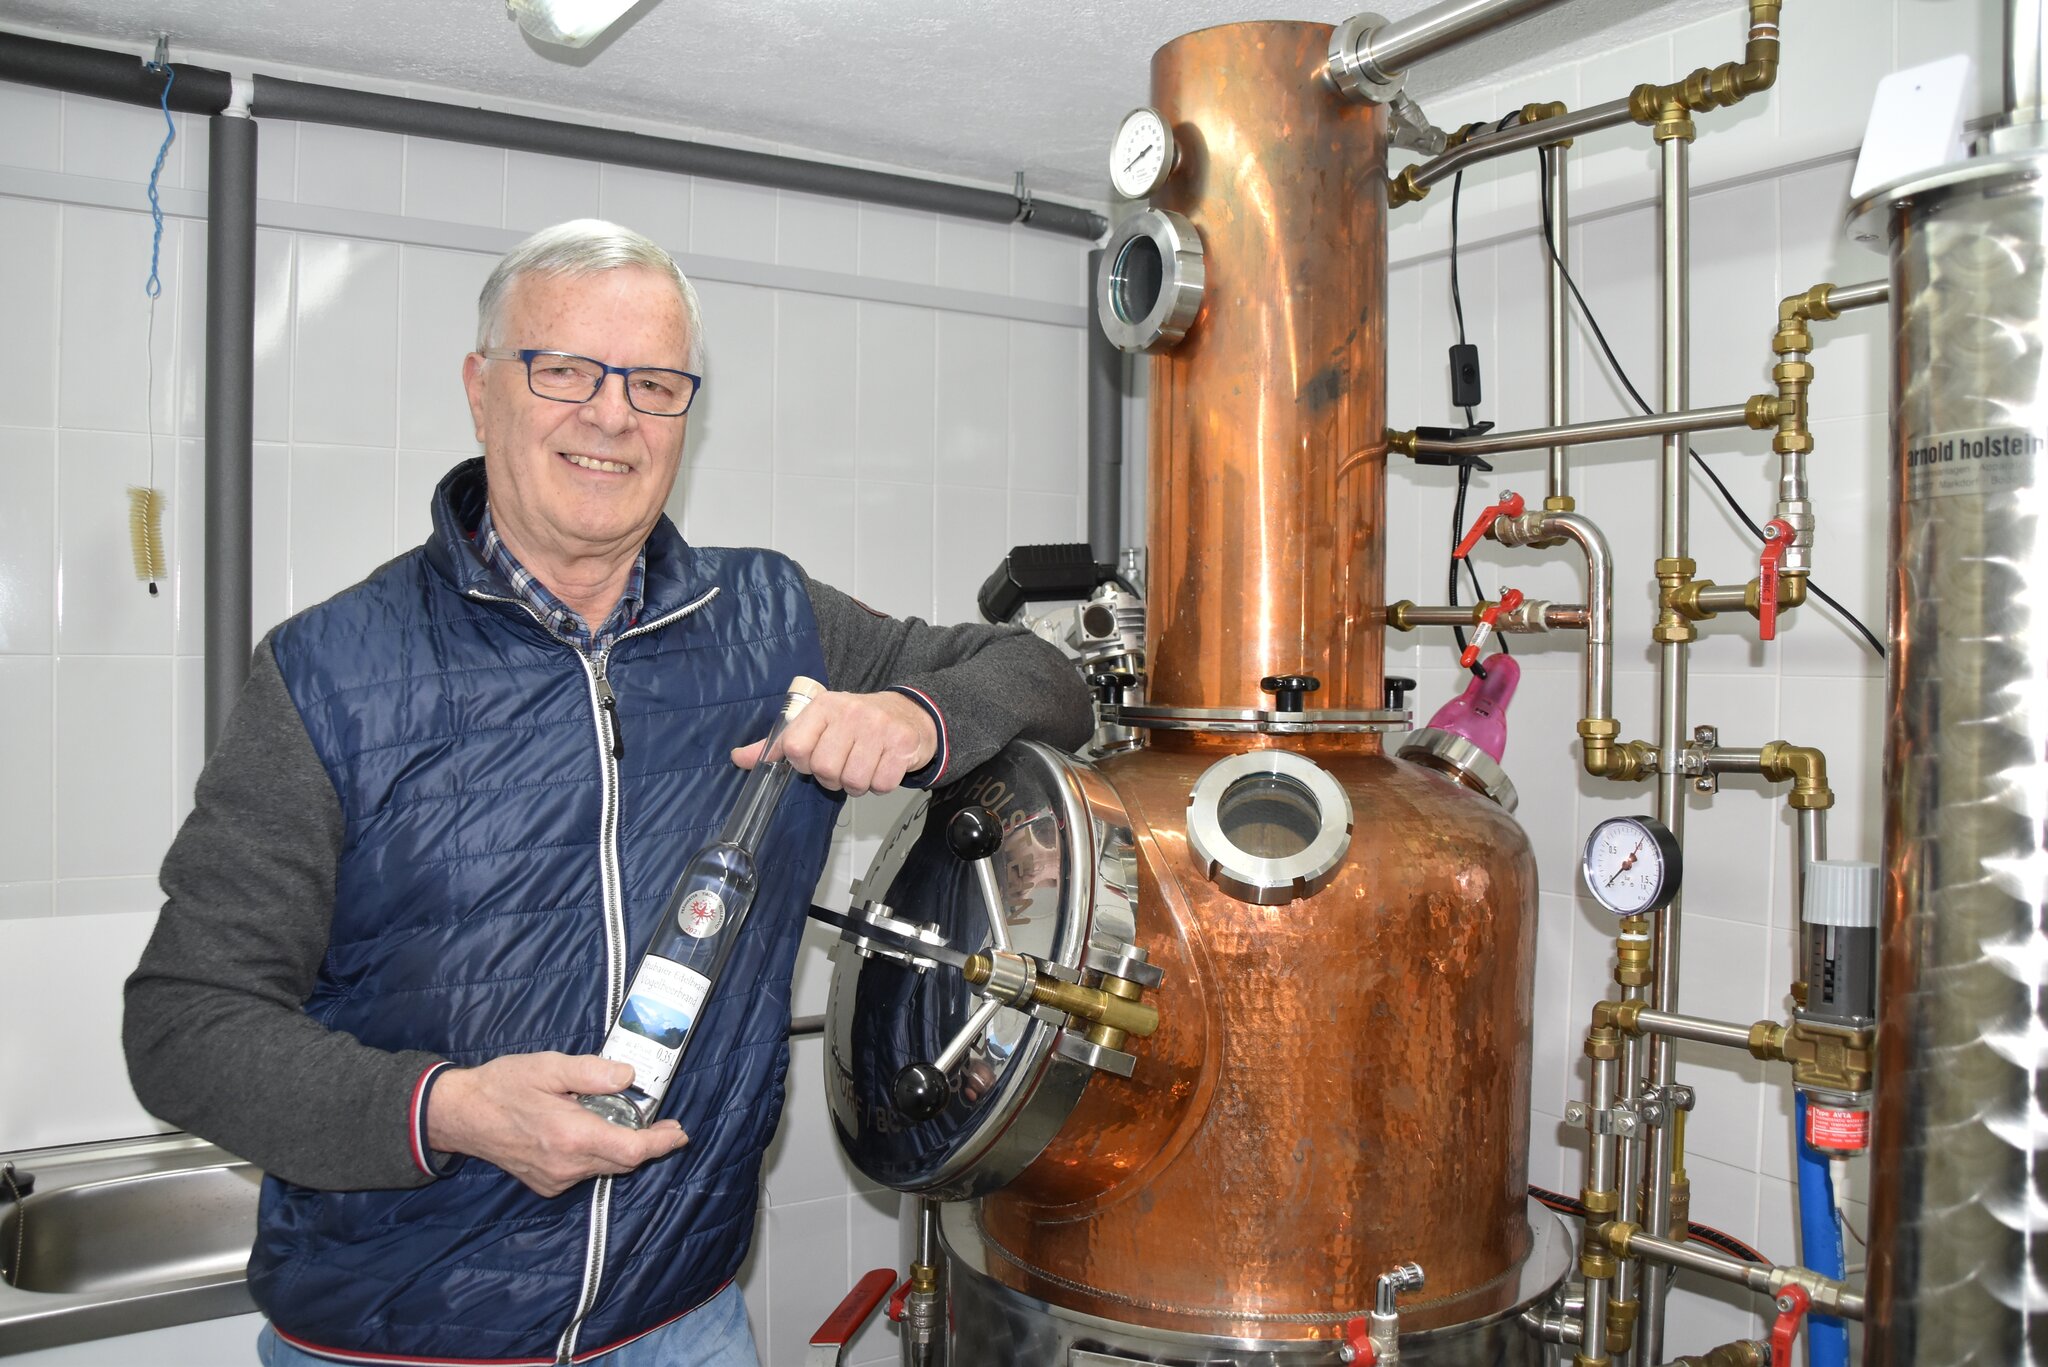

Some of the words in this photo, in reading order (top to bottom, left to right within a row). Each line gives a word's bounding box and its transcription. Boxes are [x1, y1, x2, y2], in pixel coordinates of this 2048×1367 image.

[1907, 440, 1953, 467] arnold
[1960, 433, 2044, 459] holstein
[1815, 1108, 1830, 1117] Type
